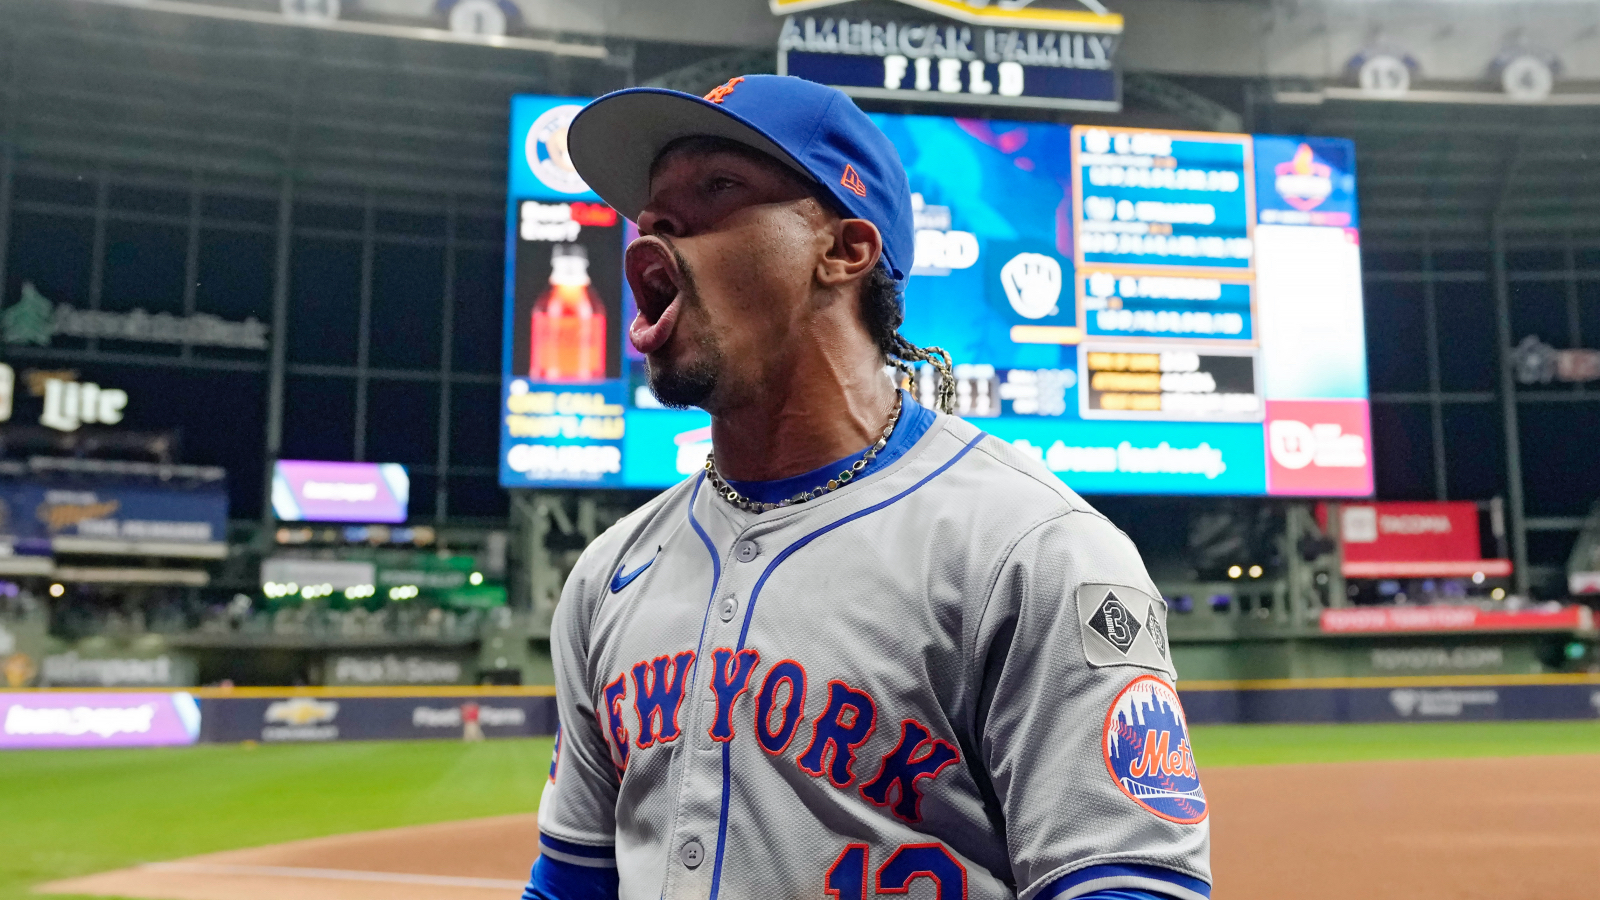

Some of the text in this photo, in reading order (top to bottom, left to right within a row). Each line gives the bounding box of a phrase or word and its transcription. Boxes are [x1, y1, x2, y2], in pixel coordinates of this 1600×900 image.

[779, 15, 1114, 71] AMERICAN FAMILY
[883, 54, 1025, 97] FIELD
[39, 378, 128, 432] Lite
[1102, 600, 1133, 646] 3
[596, 647, 961, 824] EW YORK
